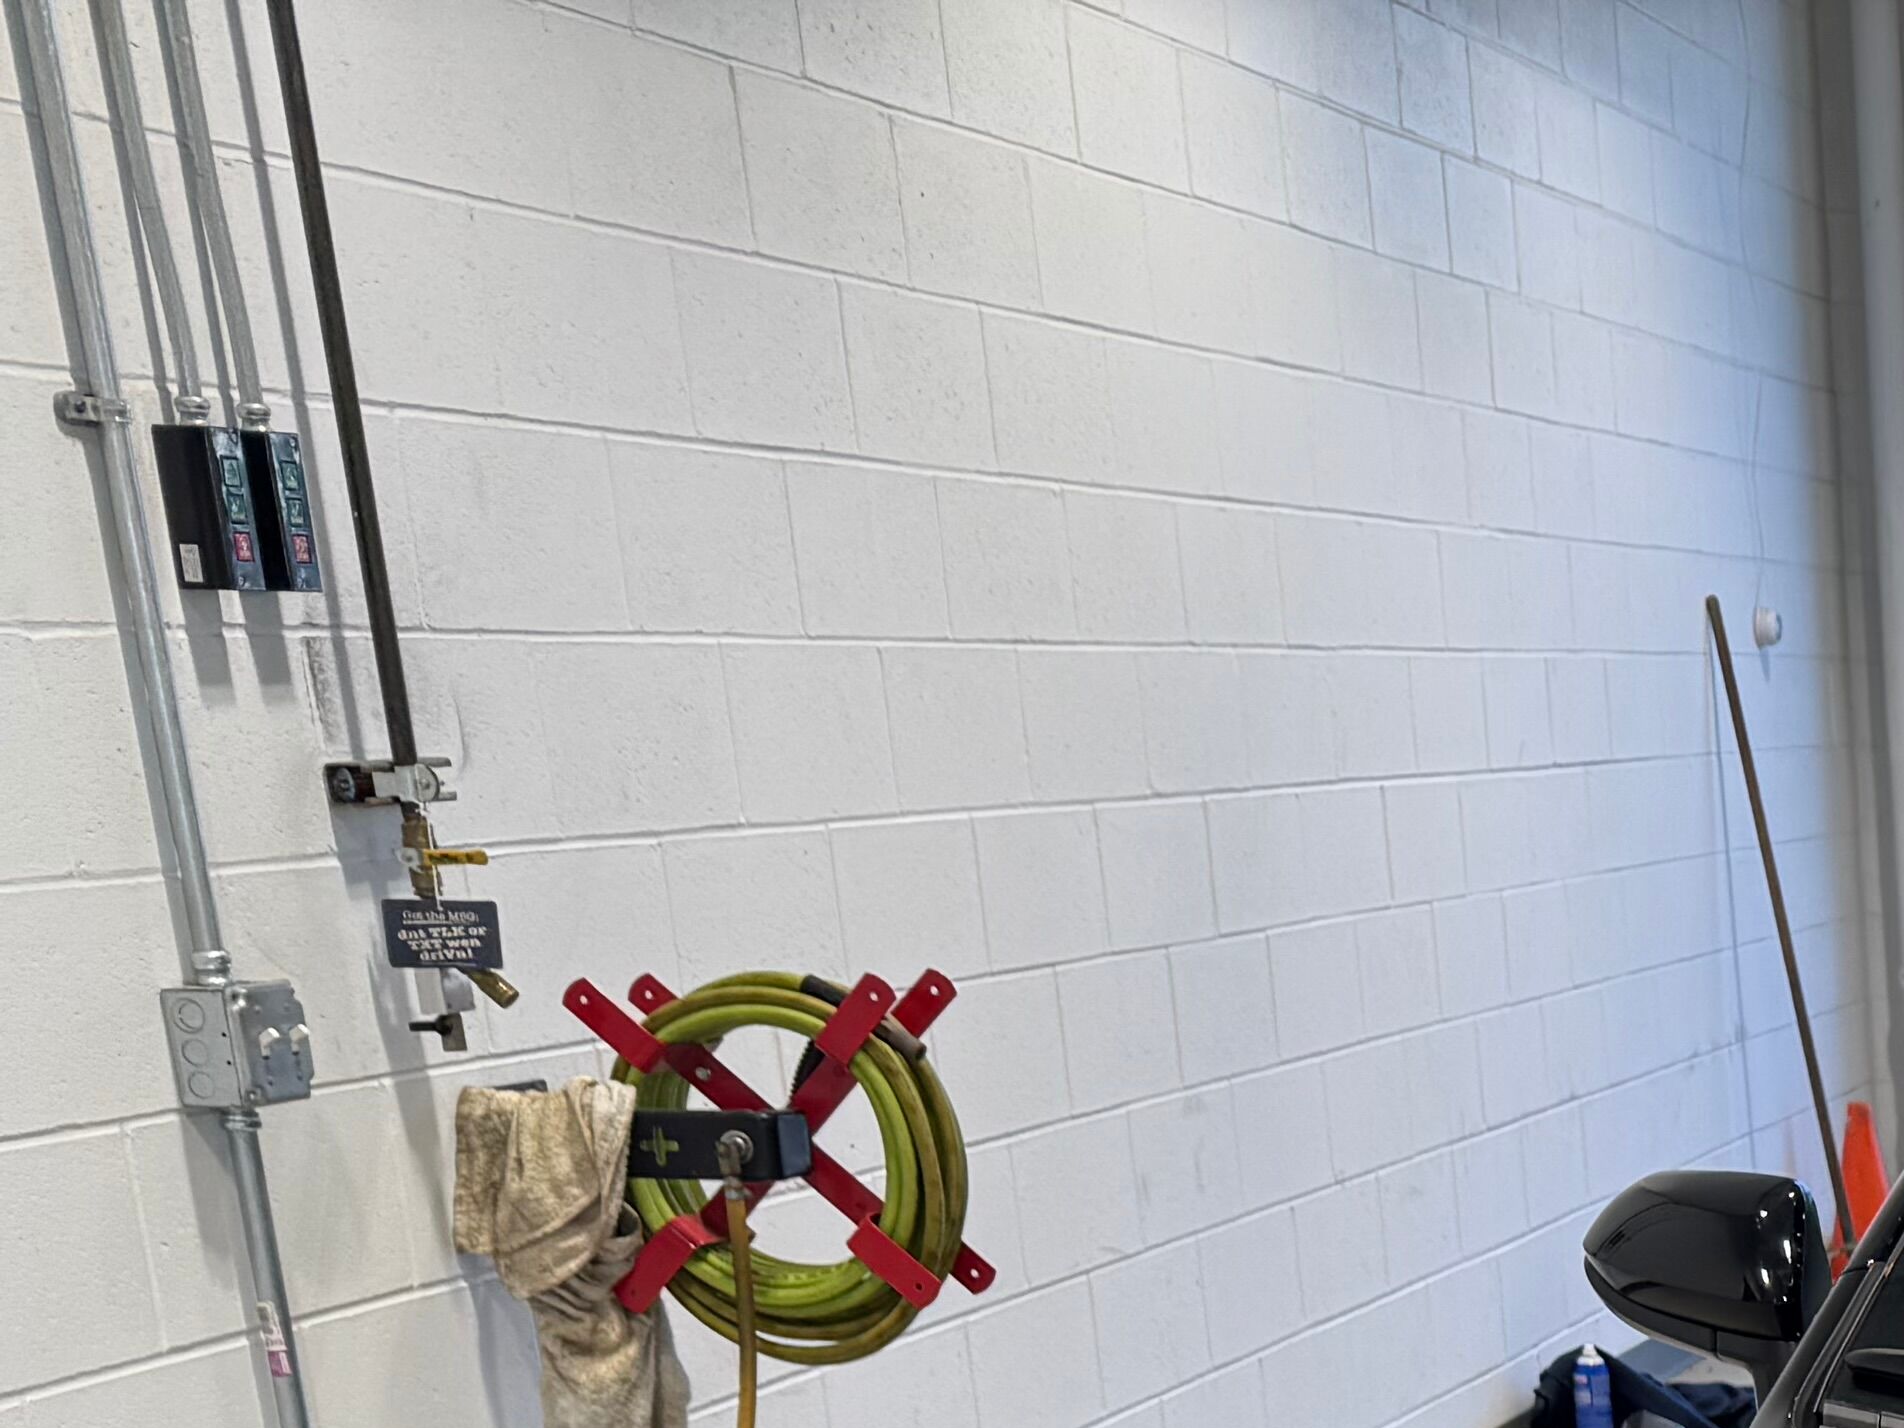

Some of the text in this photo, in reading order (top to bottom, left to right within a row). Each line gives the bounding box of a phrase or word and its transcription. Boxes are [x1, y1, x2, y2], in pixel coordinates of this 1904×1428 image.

[428, 926, 466, 938] TLK
[468, 926, 488, 936] or
[407, 937, 481, 950] TXT wen
